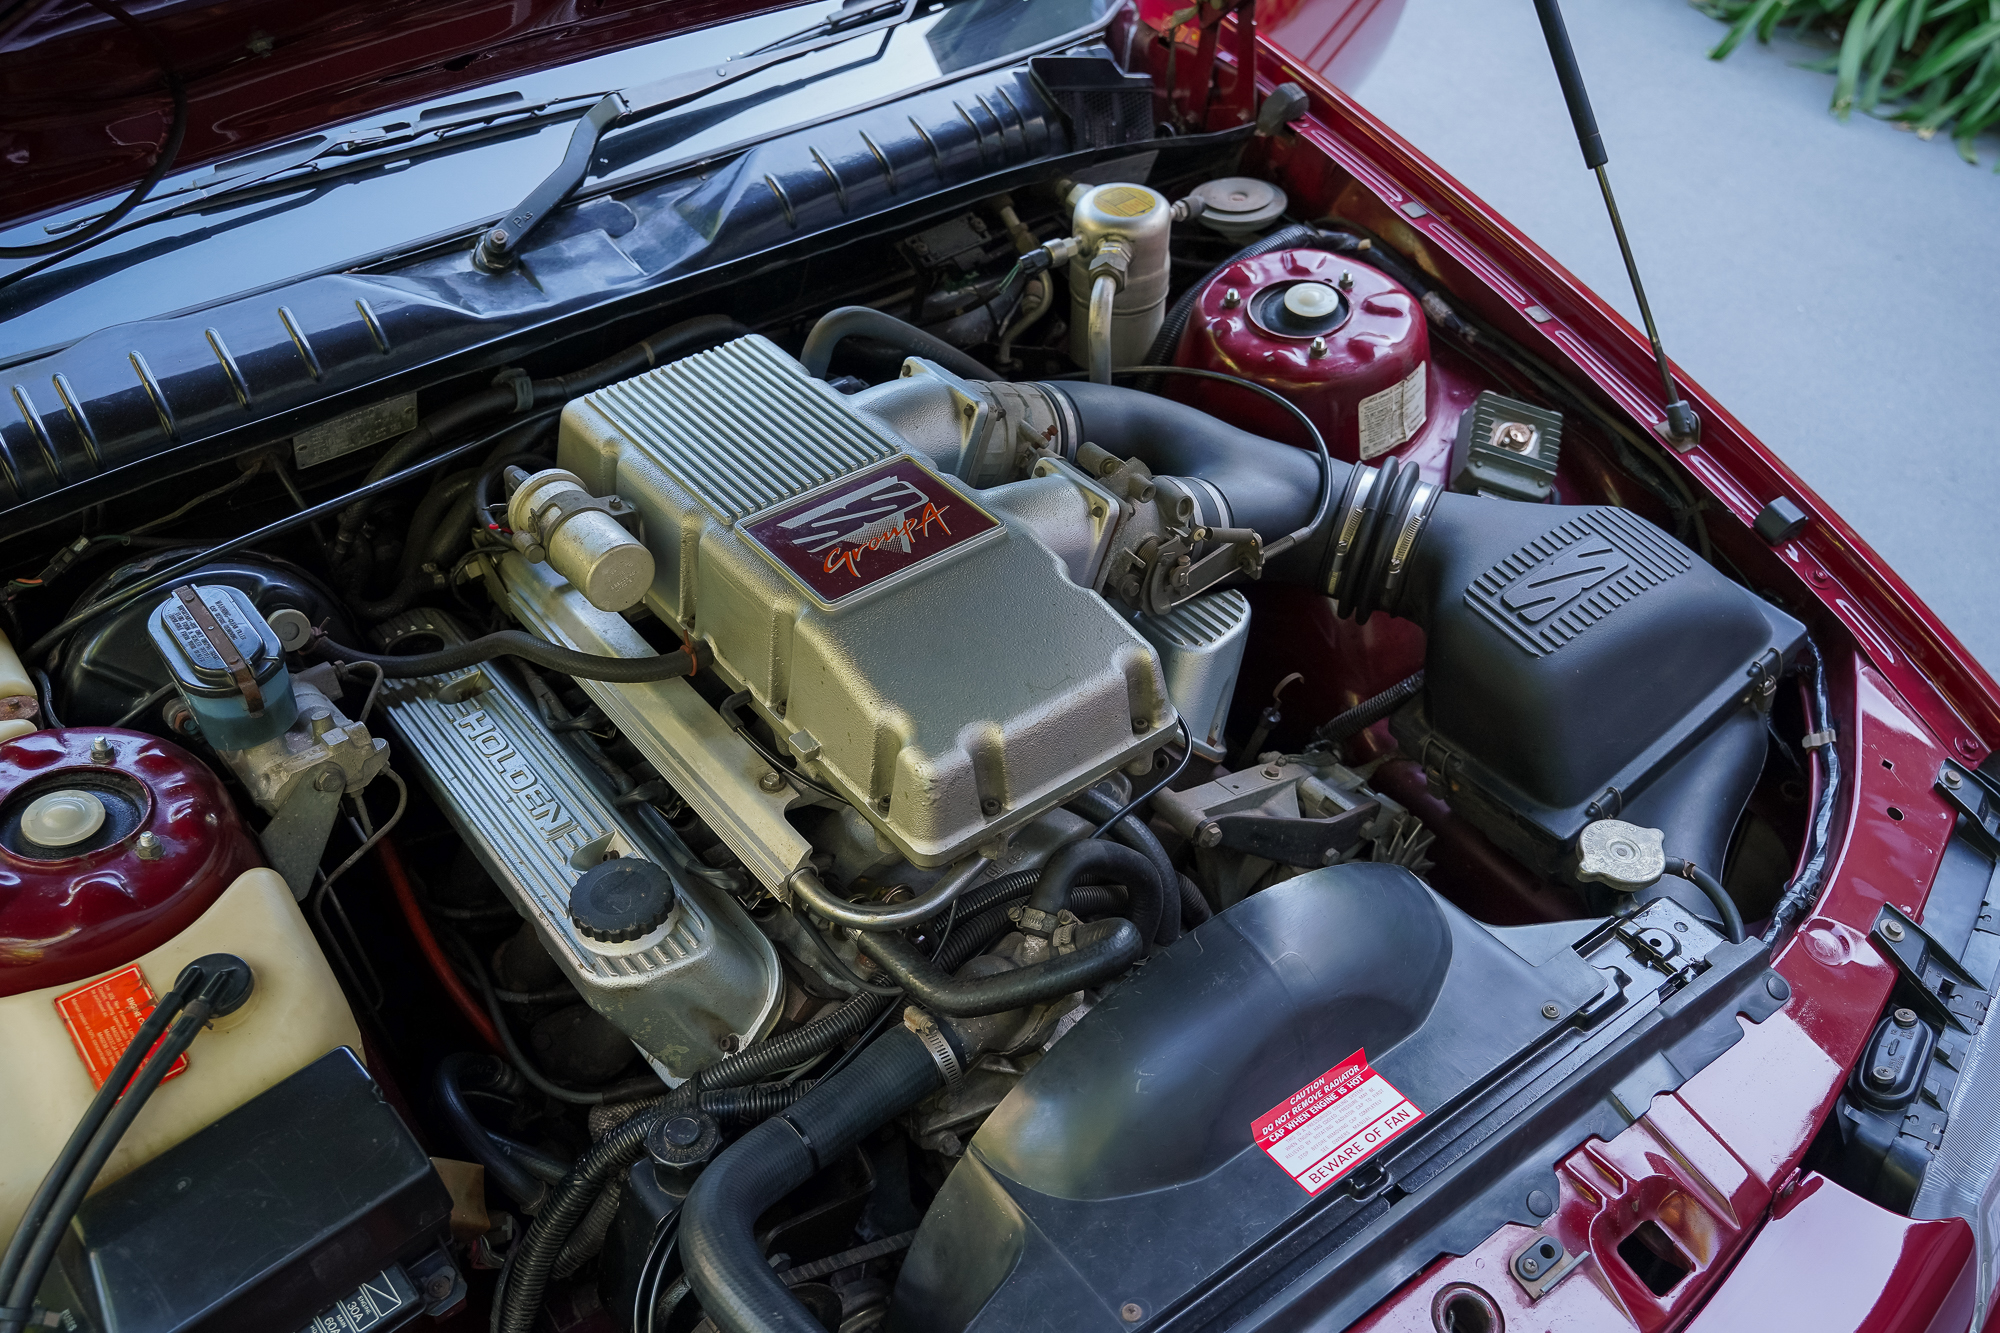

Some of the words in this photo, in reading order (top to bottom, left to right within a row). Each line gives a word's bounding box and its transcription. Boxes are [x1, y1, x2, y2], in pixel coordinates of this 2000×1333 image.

[459, 710, 574, 835] HOLDEN
[1261, 1123, 1275, 1135] DO
[1274, 1111, 1292, 1126] NOT
[1291, 1089, 1324, 1115] REMOVE
[1323, 1065, 1360, 1093] RADIATOR
[1268, 1128, 1286, 1143] CAP
[1285, 1111, 1311, 1131] WHEN
[1310, 1092, 1338, 1114] ENGINE
[1336, 1085, 1347, 1095] IS
[1347, 1075, 1364, 1089] HOT
[1289, 1077, 1326, 1105] CAUTION
[1308, 1141, 1365, 1185] BEWARE
[1364, 1127, 1383, 1145] OF
[1384, 1108, 1411, 1131] FAN
[336, 1314, 347, 1328] MAIN
[347, 1301, 364, 1323] 30A
[357, 1295, 372, 1315] ENGINE
